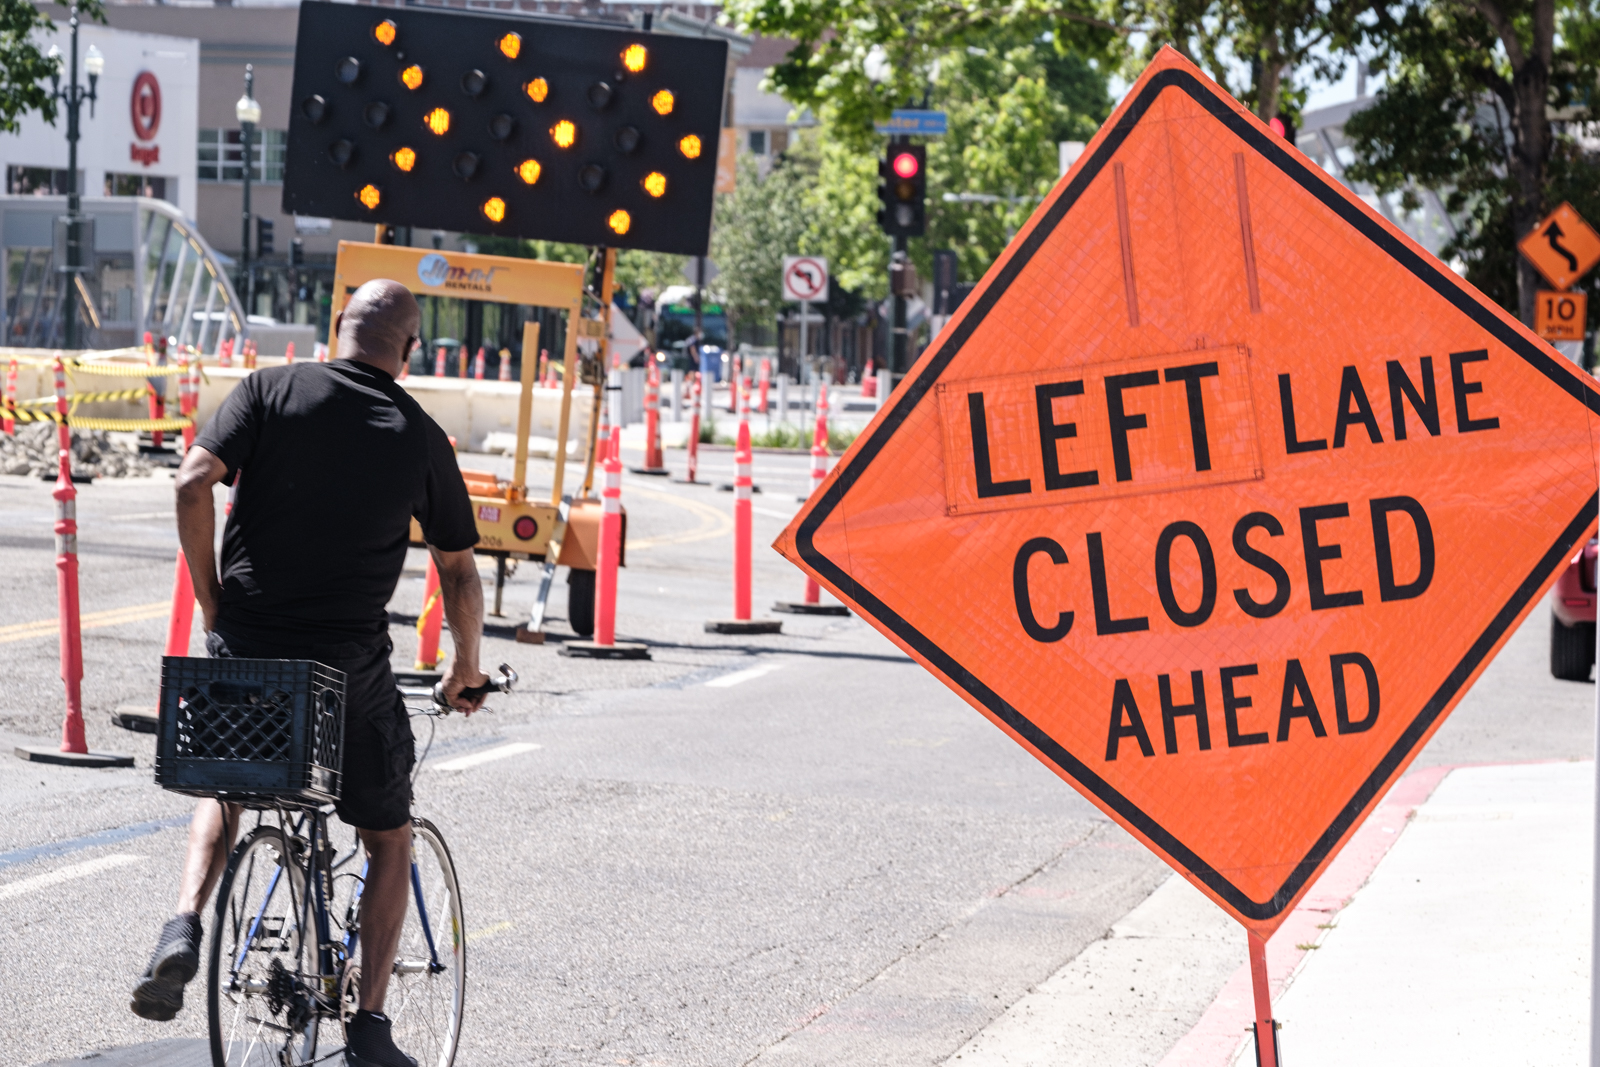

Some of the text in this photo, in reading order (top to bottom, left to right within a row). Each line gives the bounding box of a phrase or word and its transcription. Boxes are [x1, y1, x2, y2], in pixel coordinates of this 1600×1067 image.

[446, 282, 492, 292] RENTALS
[1547, 299, 1575, 320] 10
[967, 348, 1501, 499] LEFT LANE
[1012, 495, 1436, 644] CLOSED
[1104, 651, 1381, 762] AHEAD
